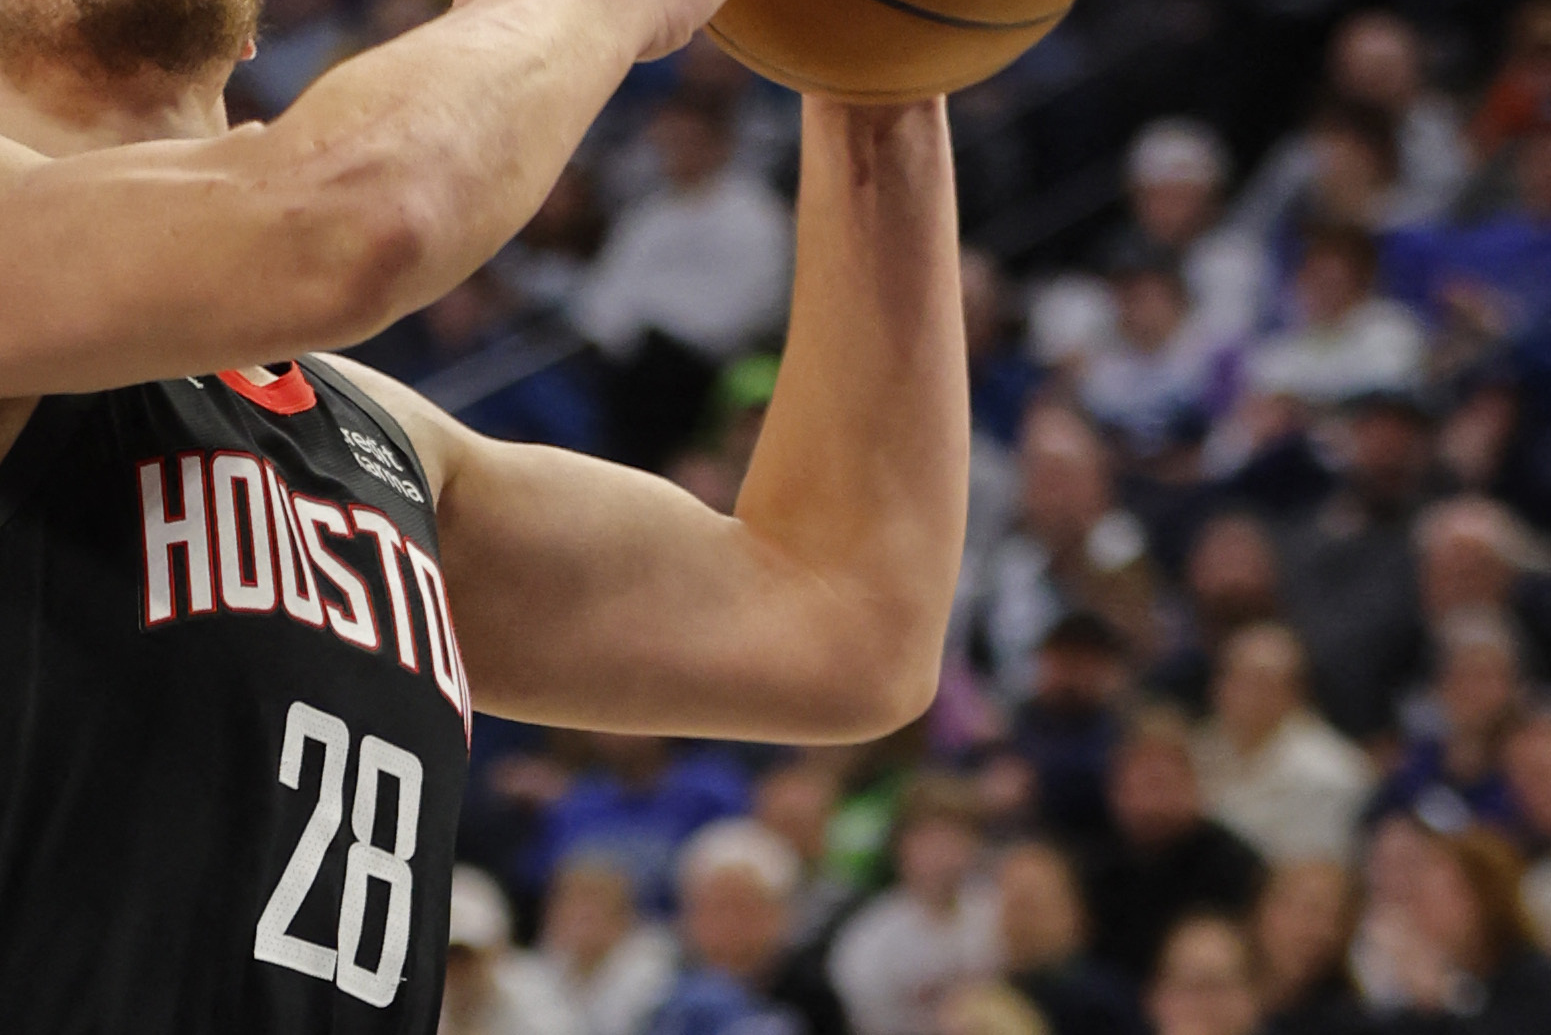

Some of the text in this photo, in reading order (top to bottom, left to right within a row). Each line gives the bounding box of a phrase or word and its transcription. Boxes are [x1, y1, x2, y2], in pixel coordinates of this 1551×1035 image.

[136, 449, 473, 756] HOUSTO
[339, 427, 405, 472] redit
[254, 700, 424, 1008] 28
